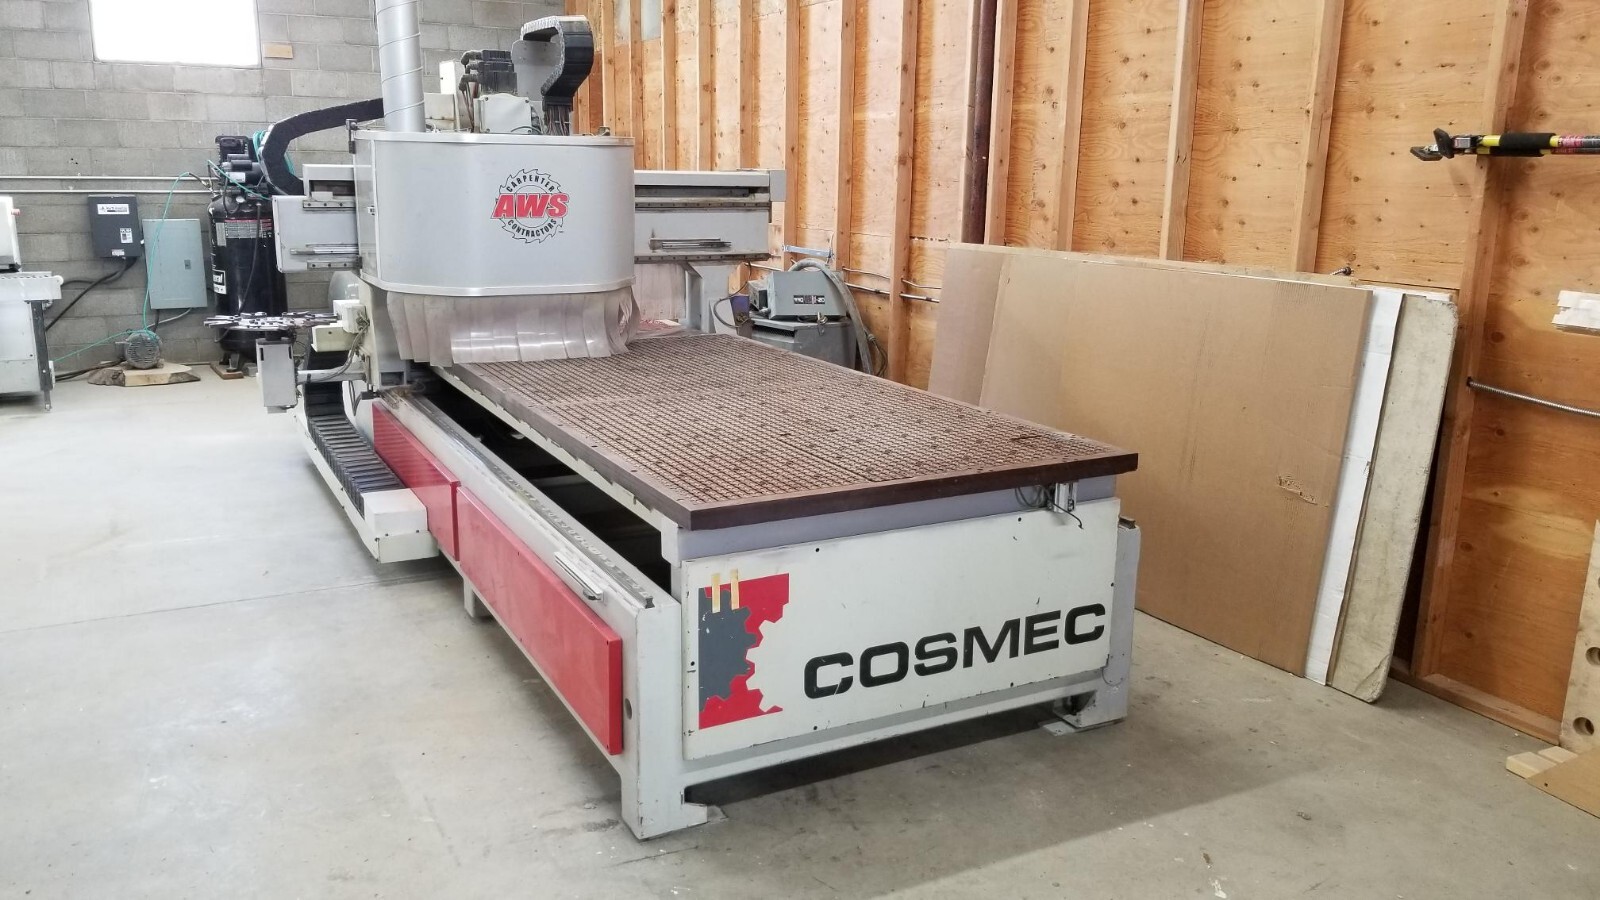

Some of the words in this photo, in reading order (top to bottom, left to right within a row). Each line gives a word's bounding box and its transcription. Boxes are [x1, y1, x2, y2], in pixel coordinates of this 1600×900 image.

[506, 174, 555, 193] CARPENTER
[490, 193, 570, 219] AWS
[507, 219, 557, 237] CONTRACTORS
[804, 603, 1106, 699] COSMEC
